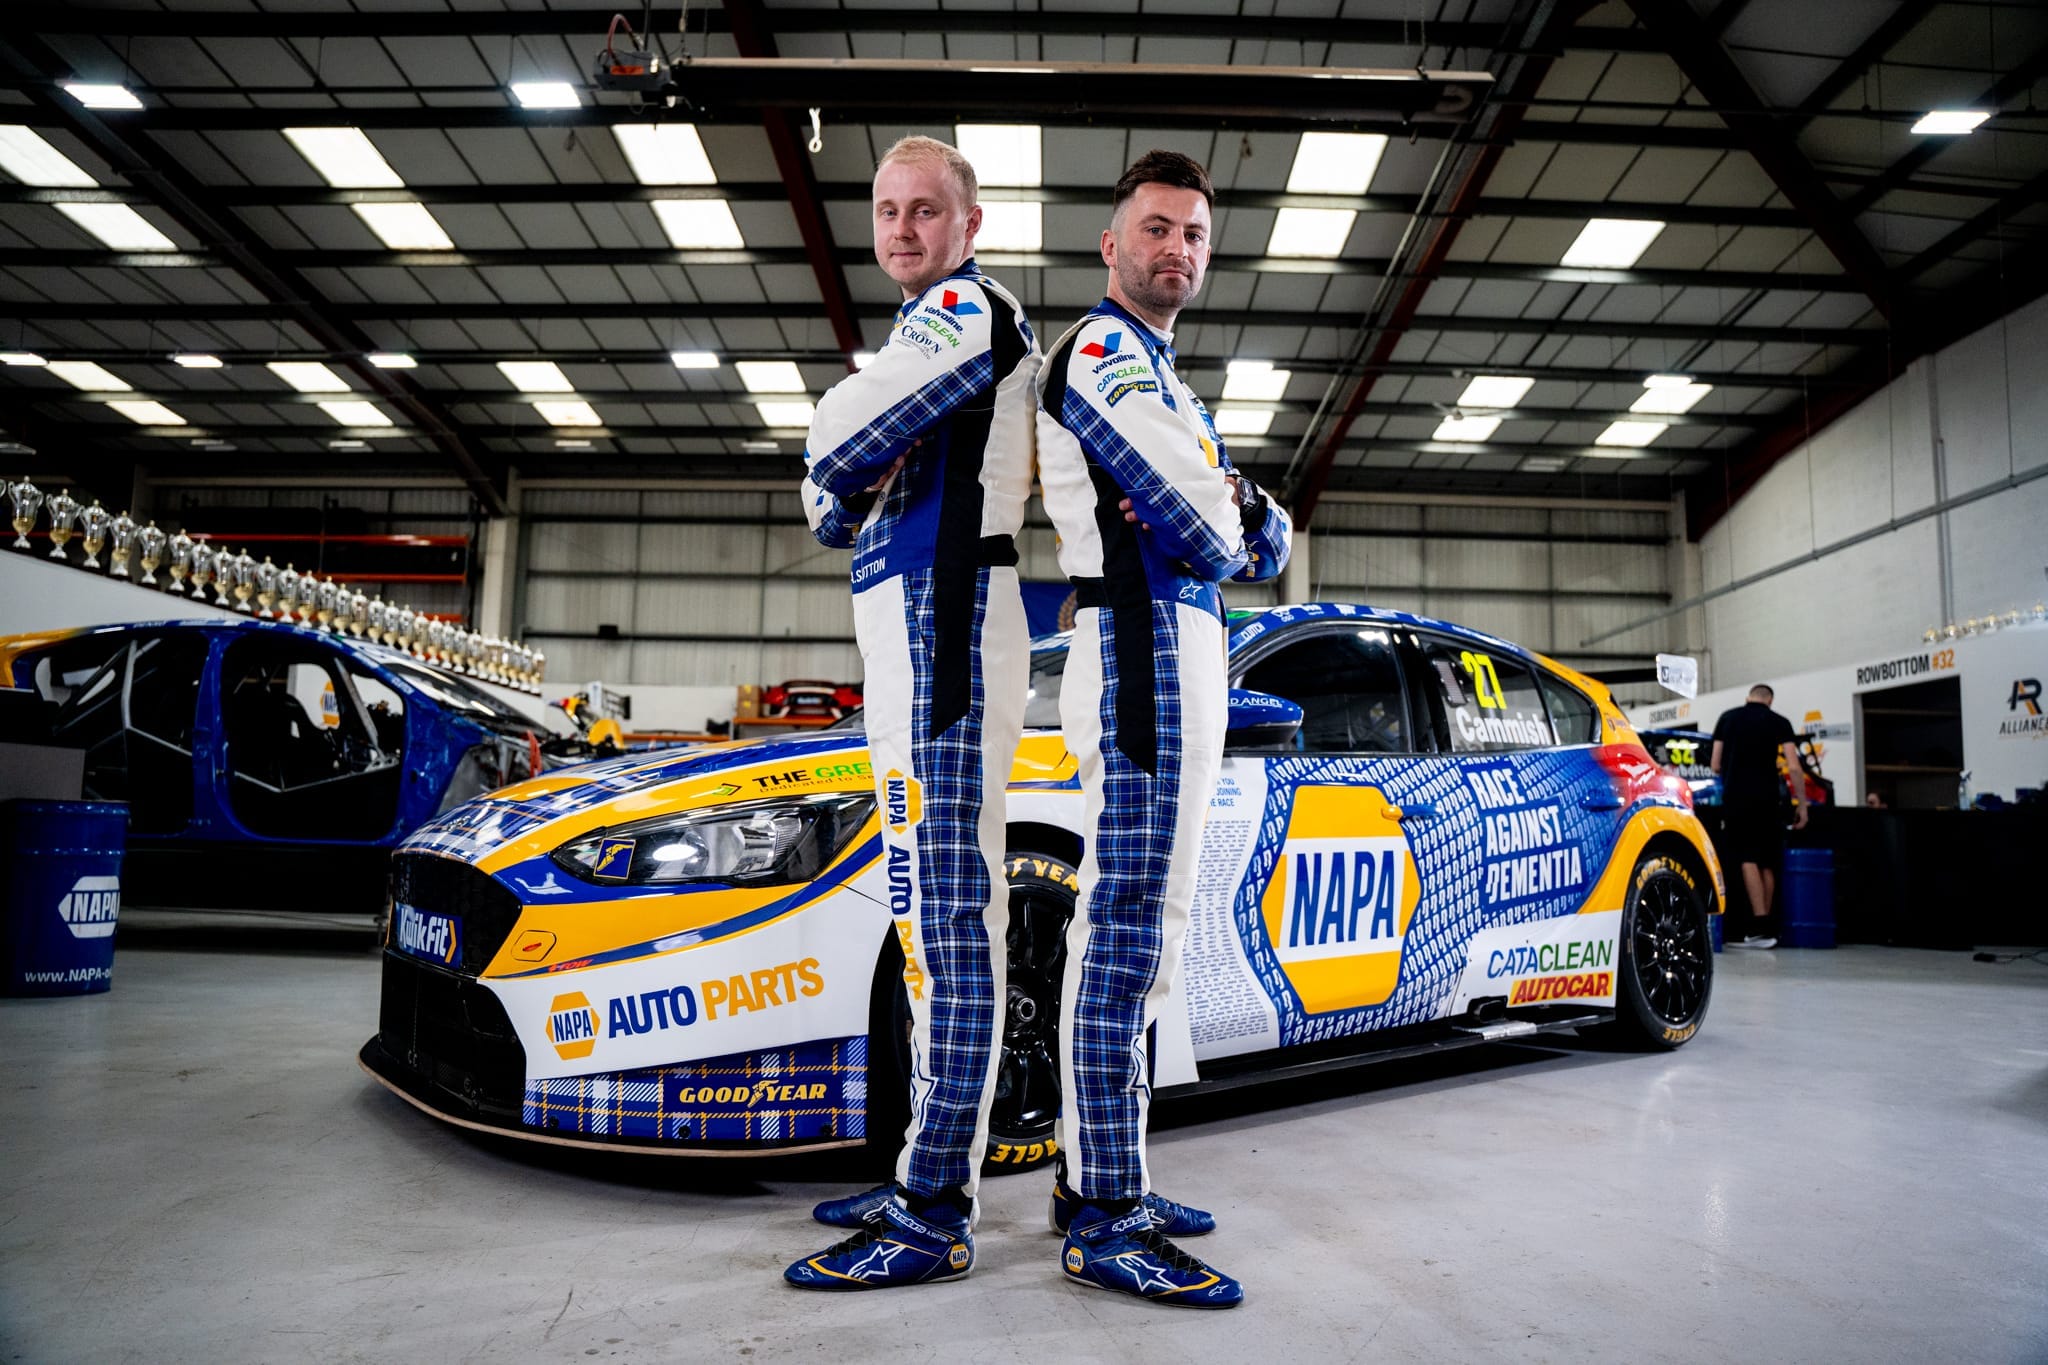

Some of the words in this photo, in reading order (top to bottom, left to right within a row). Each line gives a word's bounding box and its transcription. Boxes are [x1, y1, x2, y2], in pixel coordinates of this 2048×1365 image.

[902, 325, 942, 354] CROWN
[909, 315, 960, 349] CATACLEAN
[1092, 353, 1137, 375] Valvoline
[1461, 651, 1507, 709] 27
[1857, 653, 1930, 686] ROWBOTTOM
[1932, 648, 1955, 671] #32
[1456, 707, 1551, 745] Cammish
[752, 769, 812, 788] THE
[815, 762, 873, 778] GRE
[1467, 768, 1526, 810] RACE
[888, 780, 907, 825] NAPA
[1485, 805, 1563, 858] AGAINST
[888, 844, 912, 915] AUTO
[1485, 847, 1583, 905] DEMENTIA
[73, 892, 118, 922] NAPA
[1289, 850, 1395, 948] NAPA
[1487, 939, 1613, 979] CATACLEAN
[553, 1009, 593, 1042] NAPA
[609, 985, 697, 1039] AUTO
[701, 957, 824, 1021] PARTS
[1513, 972, 1609, 1004] AUTOCAR
[990, 1139, 1058, 1163] AGLE
[952, 1250, 968, 1263] NAPA
[1068, 1253, 1081, 1267] NAPA
